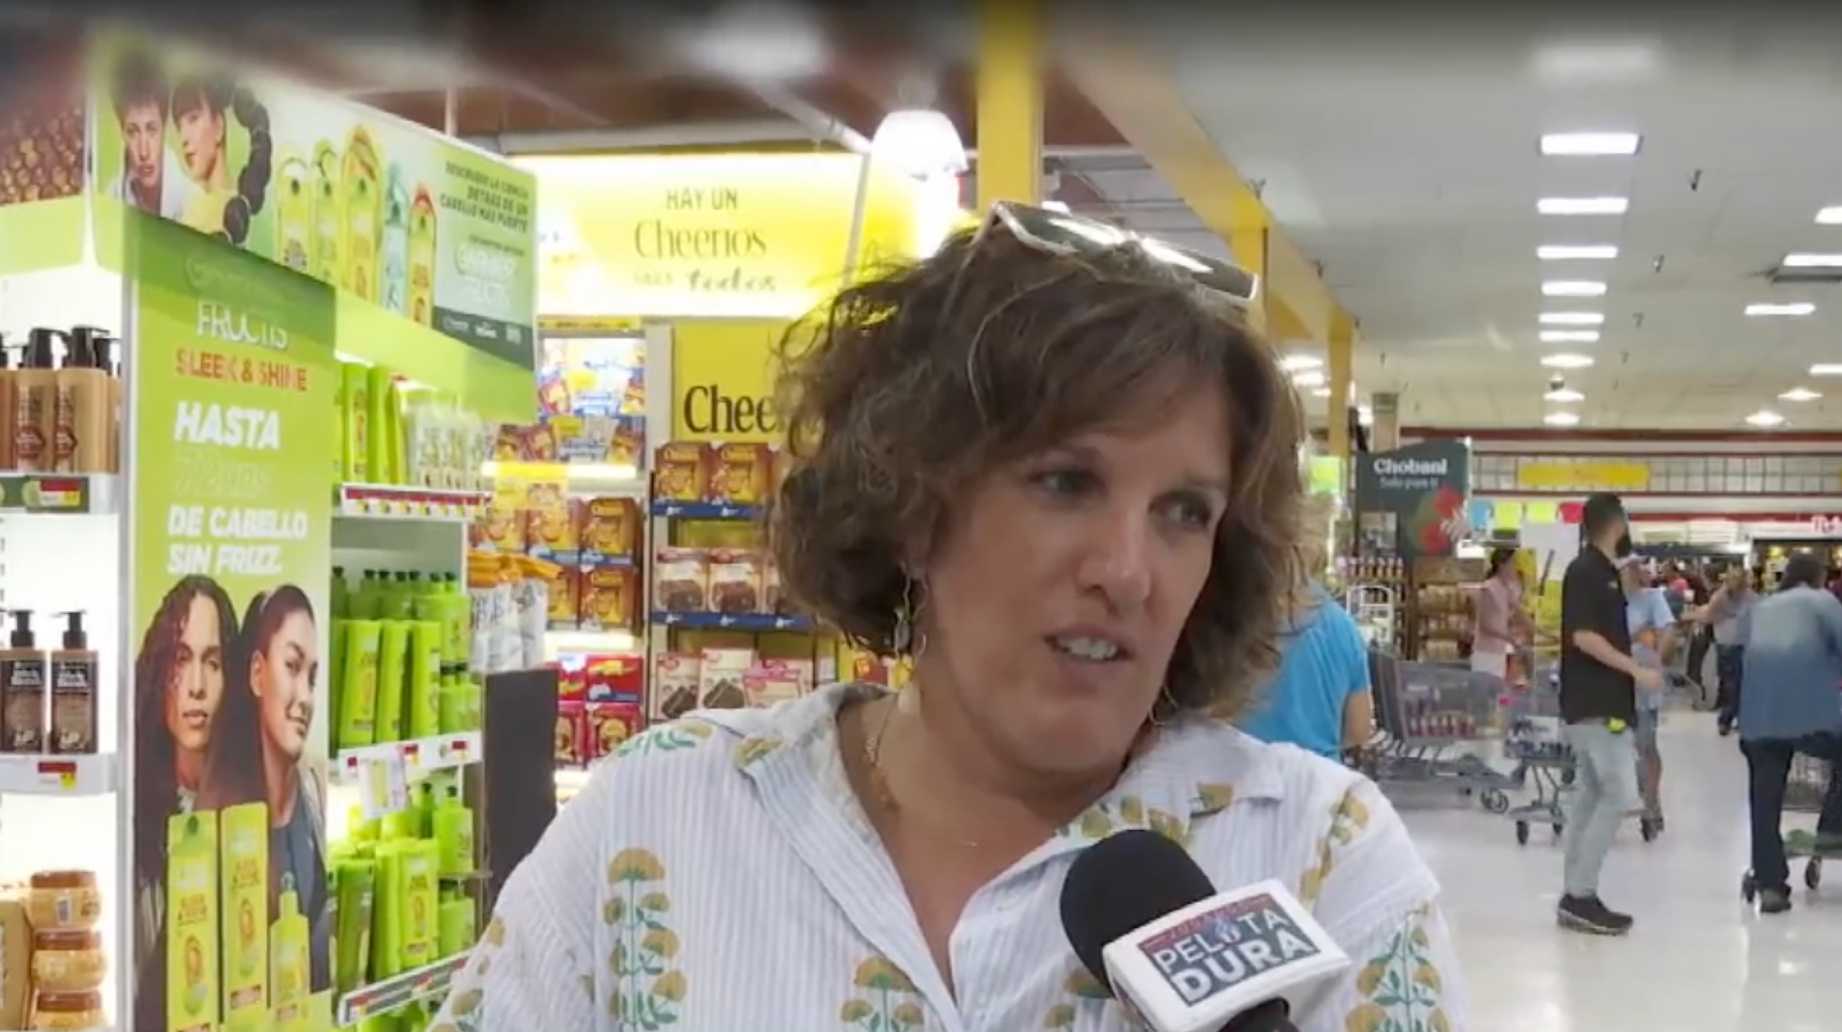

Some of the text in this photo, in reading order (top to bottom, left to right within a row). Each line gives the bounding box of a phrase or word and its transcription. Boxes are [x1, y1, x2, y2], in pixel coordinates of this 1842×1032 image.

[666, 187, 738, 210] HAY UN
[176, 349, 307, 392] SLEEK & SHINE
[173, 401, 280, 450] HASTA
[1373, 458, 1448, 475] Chobani
[167, 505, 307, 539] DE CABELLO
[167, 543, 213, 574] SIN
[1171, 927, 1316, 1003] DURA
